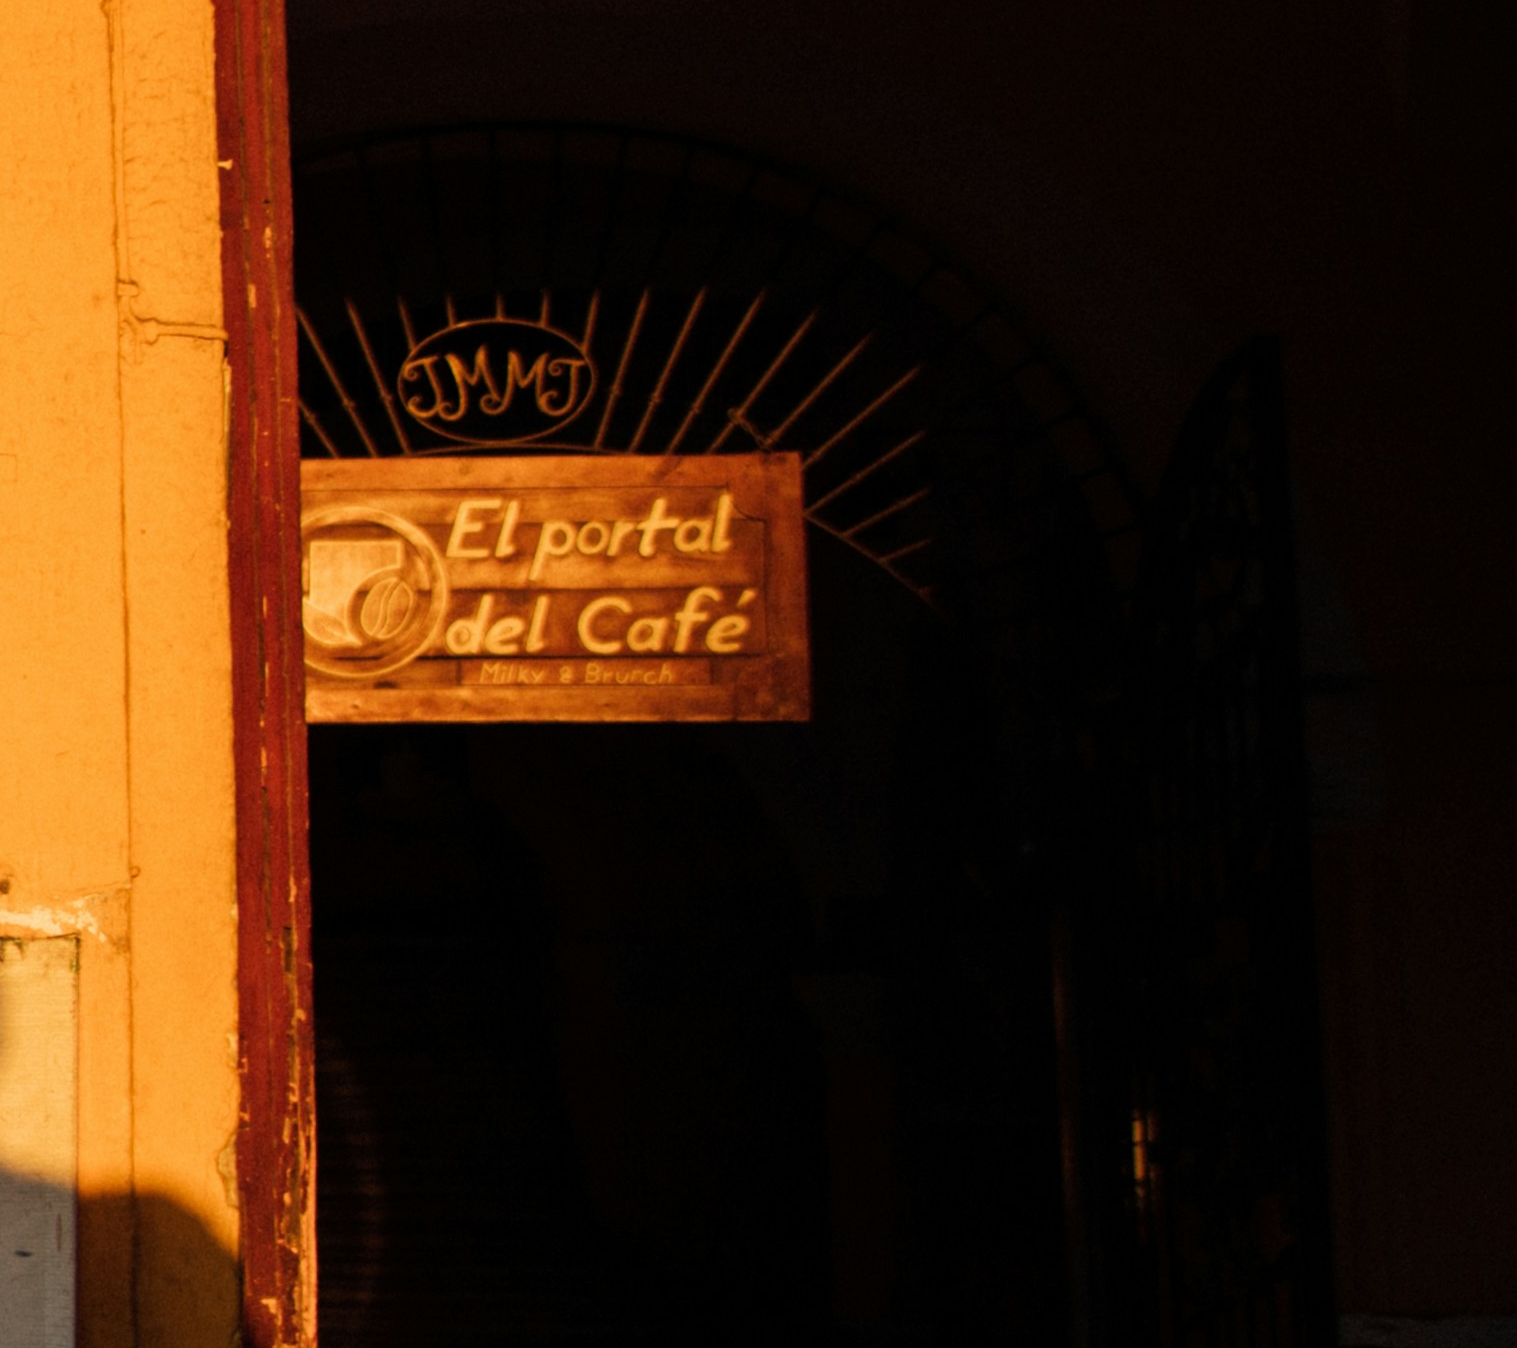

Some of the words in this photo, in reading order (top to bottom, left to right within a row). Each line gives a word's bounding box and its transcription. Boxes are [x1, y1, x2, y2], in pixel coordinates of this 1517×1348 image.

[448, 496, 519, 560] El
[528, 490, 736, 581] portal
[444, 593, 551, 657] del
[576, 588, 757, 657] Café
[479, 661, 545, 685] Milky
